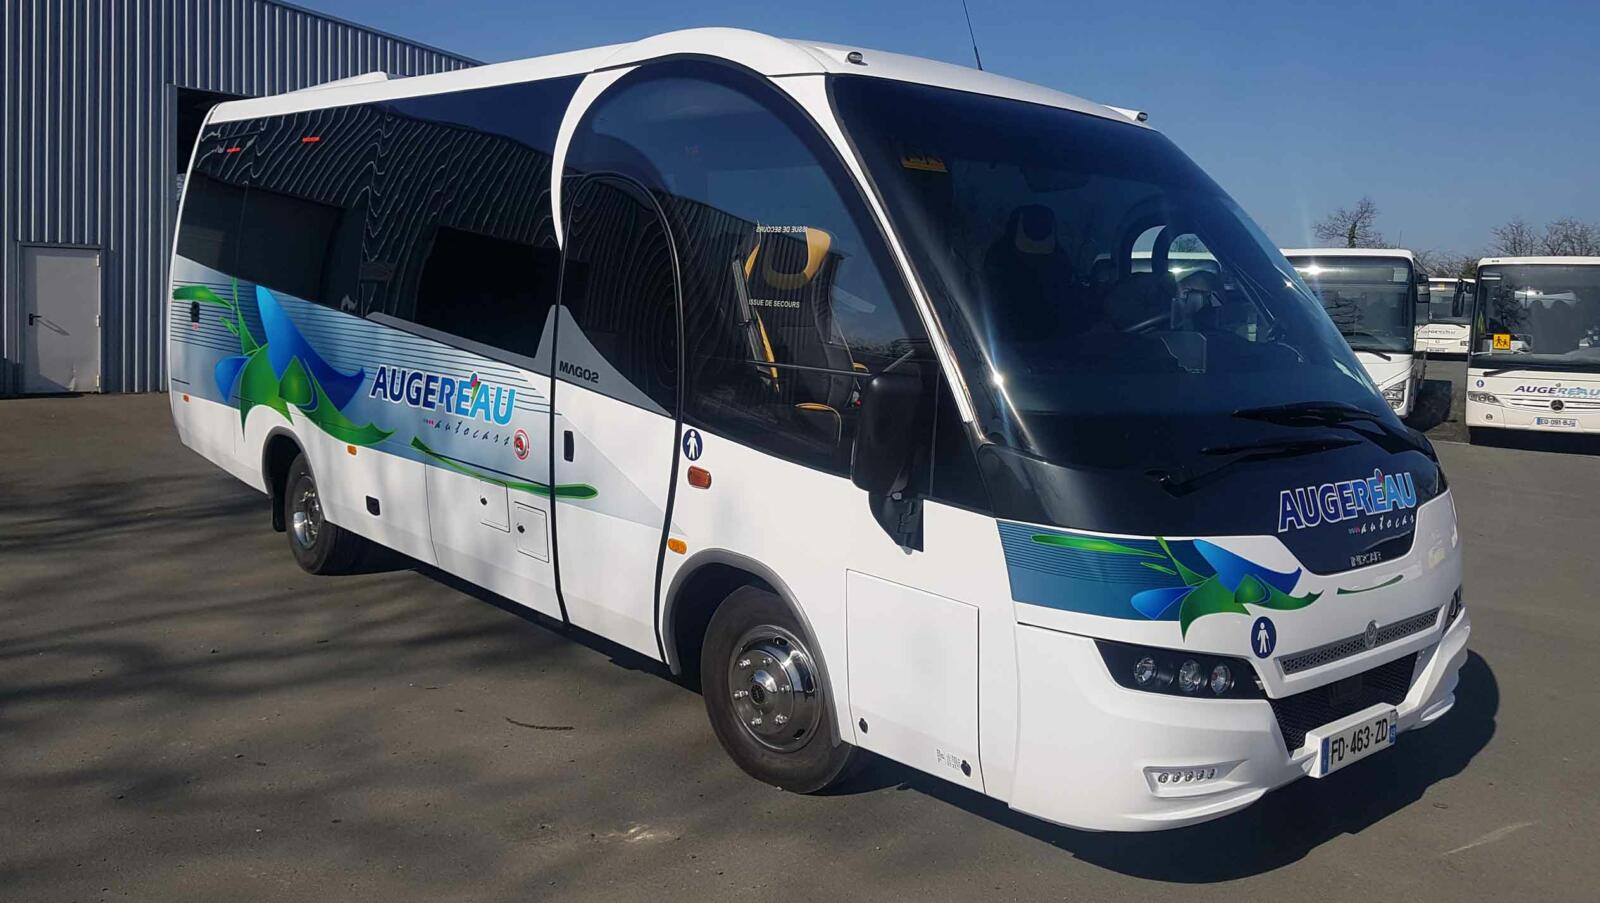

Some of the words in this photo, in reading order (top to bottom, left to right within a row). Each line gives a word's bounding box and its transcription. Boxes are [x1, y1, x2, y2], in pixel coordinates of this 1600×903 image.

[749, 298, 765, 306] ISSUE
[765, 299, 773, 307] DE
[773, 300, 800, 308] SECOURS
[1331, 718, 1388, 765] FD-463-ZD
